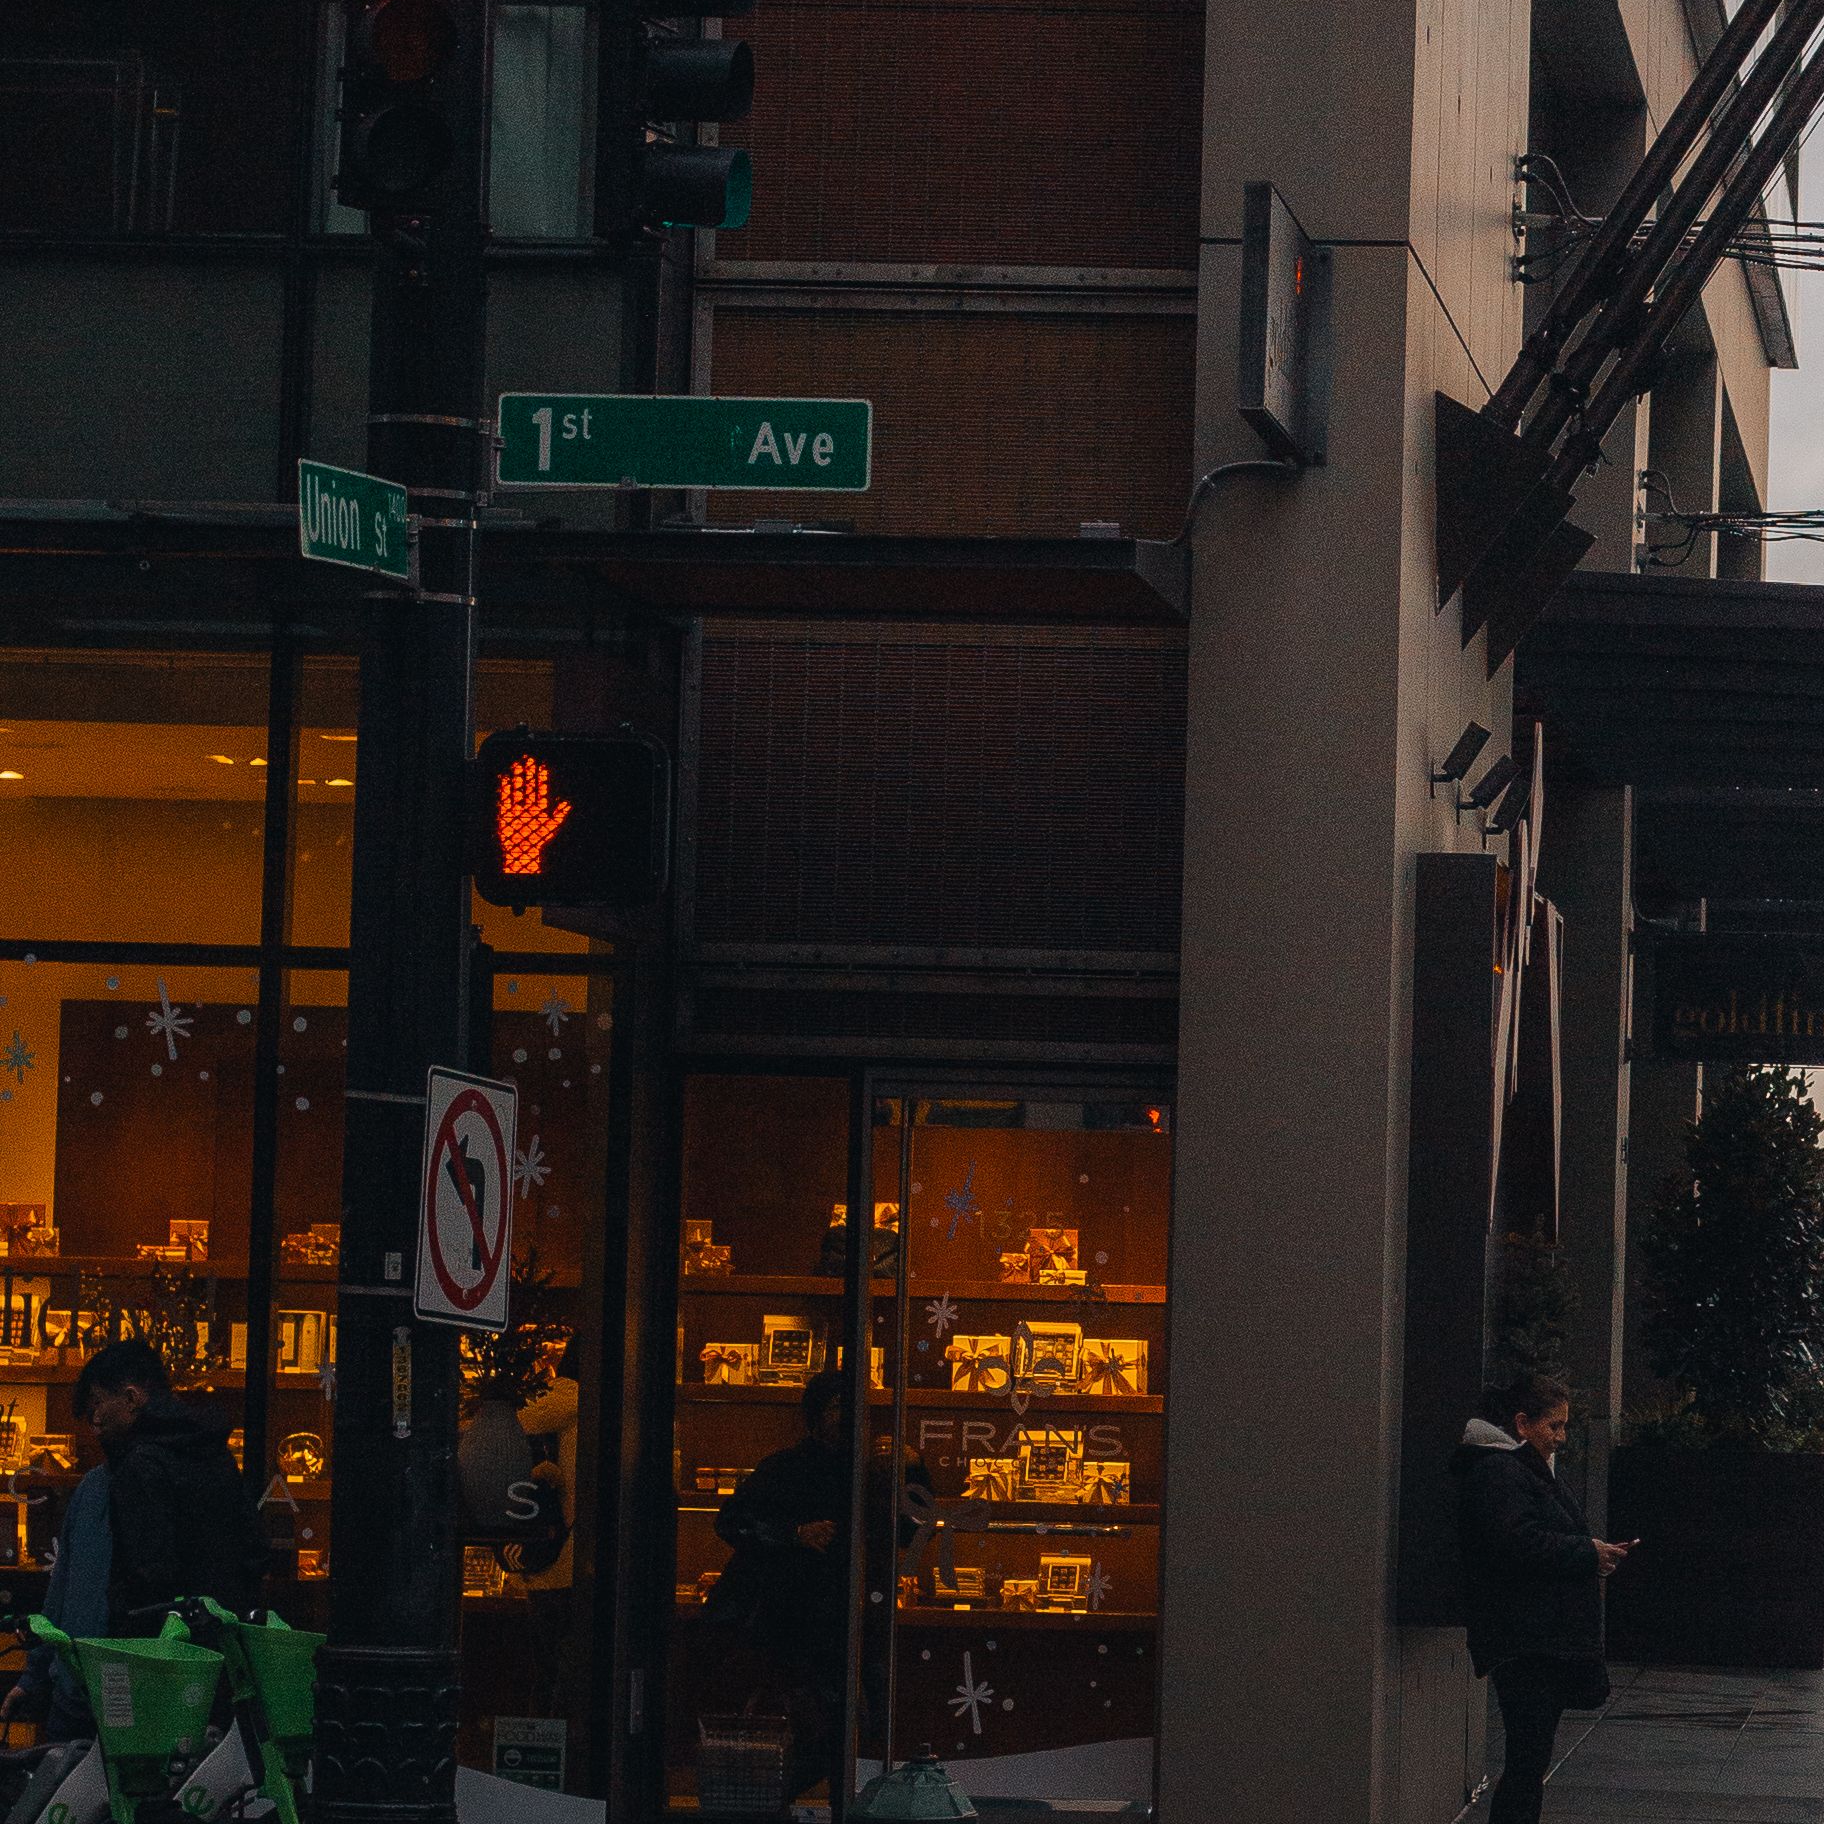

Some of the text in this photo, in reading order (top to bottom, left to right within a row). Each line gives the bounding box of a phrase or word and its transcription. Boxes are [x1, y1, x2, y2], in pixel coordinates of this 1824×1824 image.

[530, 406, 835, 471] 1st Ave
[306, 472, 362, 551] Union
[918, 1419, 1123, 1457] FRAN'S
